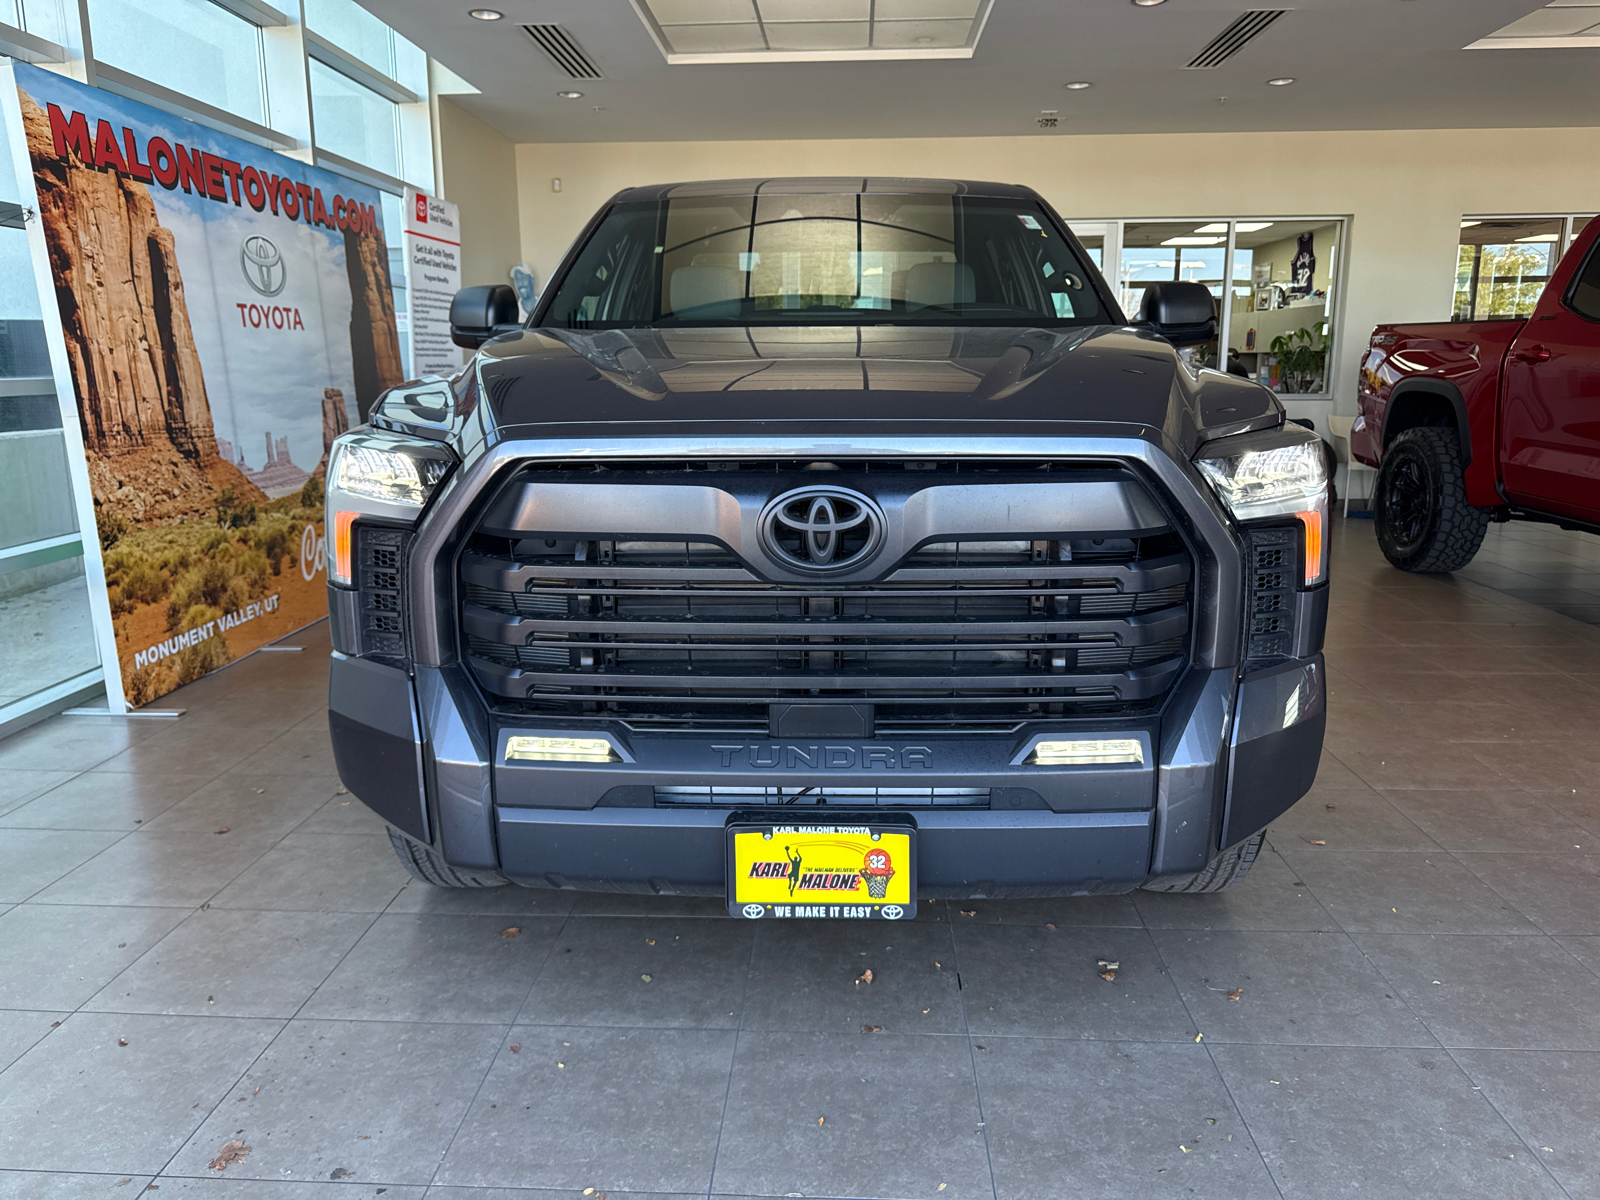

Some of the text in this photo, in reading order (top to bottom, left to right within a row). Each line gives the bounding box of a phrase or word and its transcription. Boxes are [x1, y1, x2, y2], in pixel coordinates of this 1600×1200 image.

[46, 102, 378, 237] MALONETOYOTA.COM
[429, 202, 445, 214] Certified
[429, 213, 454, 227] Used Vehicles
[416, 244, 424, 253] Get
[433, 248, 442, 257] with
[442, 249, 455, 260] Toyota
[413, 256, 457, 272] Certified Used Vehicles
[236, 303, 305, 331] TOYOTA
[301, 524, 327, 581] Co
[134, 594, 280, 670] MONUMENT VALLEY, UT
[710, 745, 934, 769] TUNDRA
[749, 862, 790, 879] KARL
[869, 855, 886, 869] 32
[798, 873, 861, 891] MALONE
[774, 906, 872, 918] WE MAKE IT EASY
